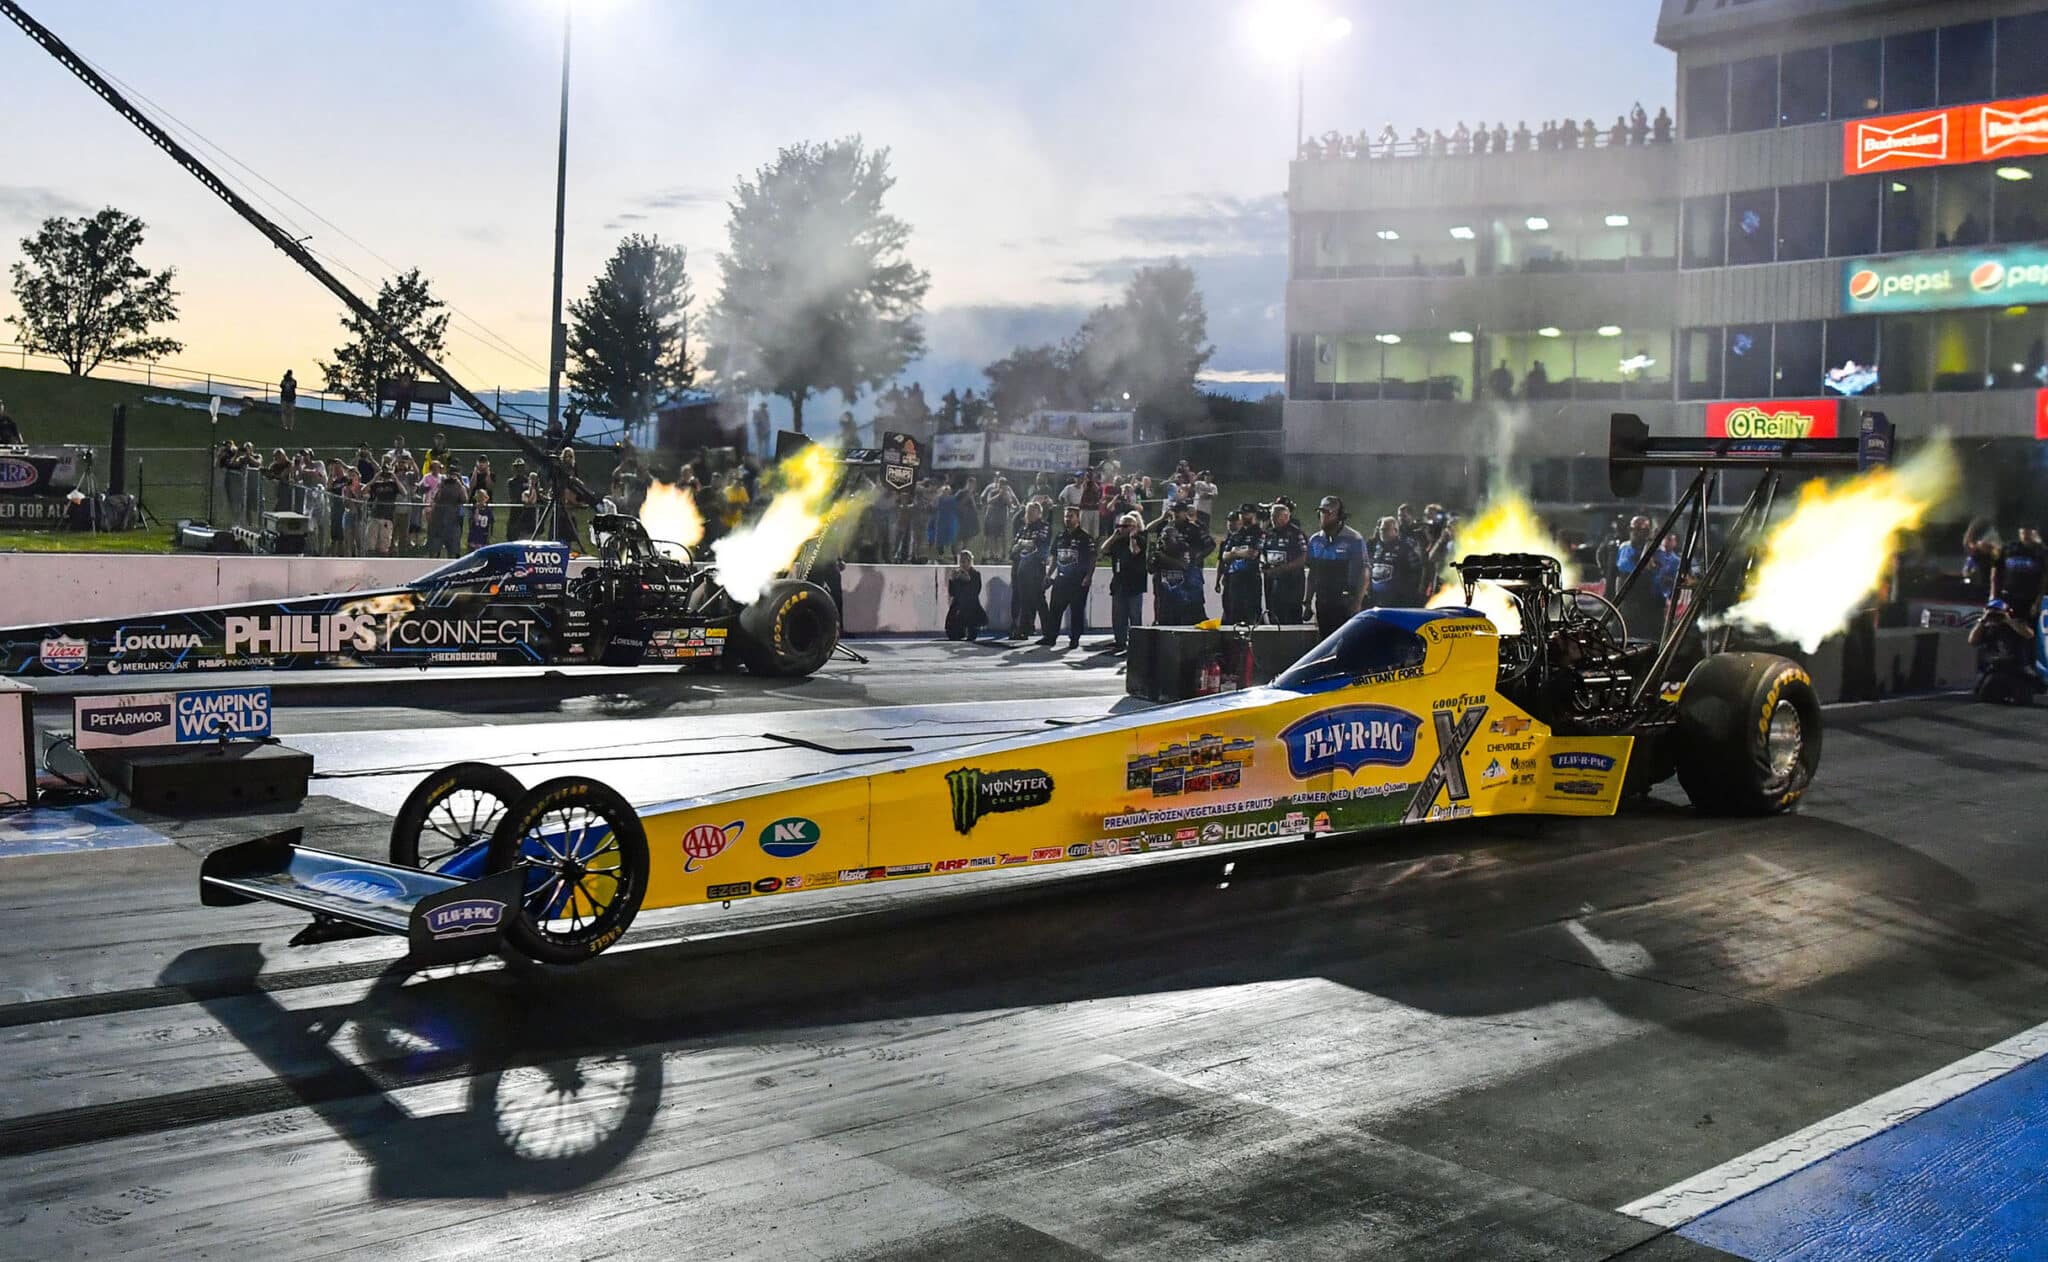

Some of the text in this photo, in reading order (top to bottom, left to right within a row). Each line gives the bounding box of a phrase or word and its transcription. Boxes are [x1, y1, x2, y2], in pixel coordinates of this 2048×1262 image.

[1864, 133, 1940, 152] Budweiser
[1883, 268, 1953, 296] pepsi
[1731, 412, 1807, 438] O'Reilly
[20, 503, 44, 518] FOR
[524, 551, 562, 564] KATO
[534, 566, 564, 575] TOYOTA
[224, 614, 536, 655] PHILLIPS CONNECT
[1441, 624, 1493, 633] CORNWELL
[46, 646, 85, 657] LUCAS
[125, 633, 204, 651] OKUMA
[437, 652, 498, 662] HENDRICKSON
[1352, 666, 1425, 687] BRITTANY FORCE
[178, 692, 268, 715] CAMPING
[90, 711, 164, 727] PETARMOR
[179, 710, 269, 738] WORLD
[1487, 741, 1532, 752] CHEVROLET
[981, 776, 1048, 796] MONSTER
[991, 793, 1039, 805] ENERGY
[1292, 792, 1327, 804] FARMER
[1104, 798, 1273, 829] PREMIUM FROZEN VEGETABLES & FRUITS
[774, 821, 807, 842] NK
[683, 826, 725, 858] AAA
[934, 858, 969, 872] ARP
[970, 857, 996, 867] MAHLE
[1032, 848, 1063, 860] SIMPSON
[1149, 833, 1173, 844] WELD
[1225, 821, 1278, 840] HURCO
